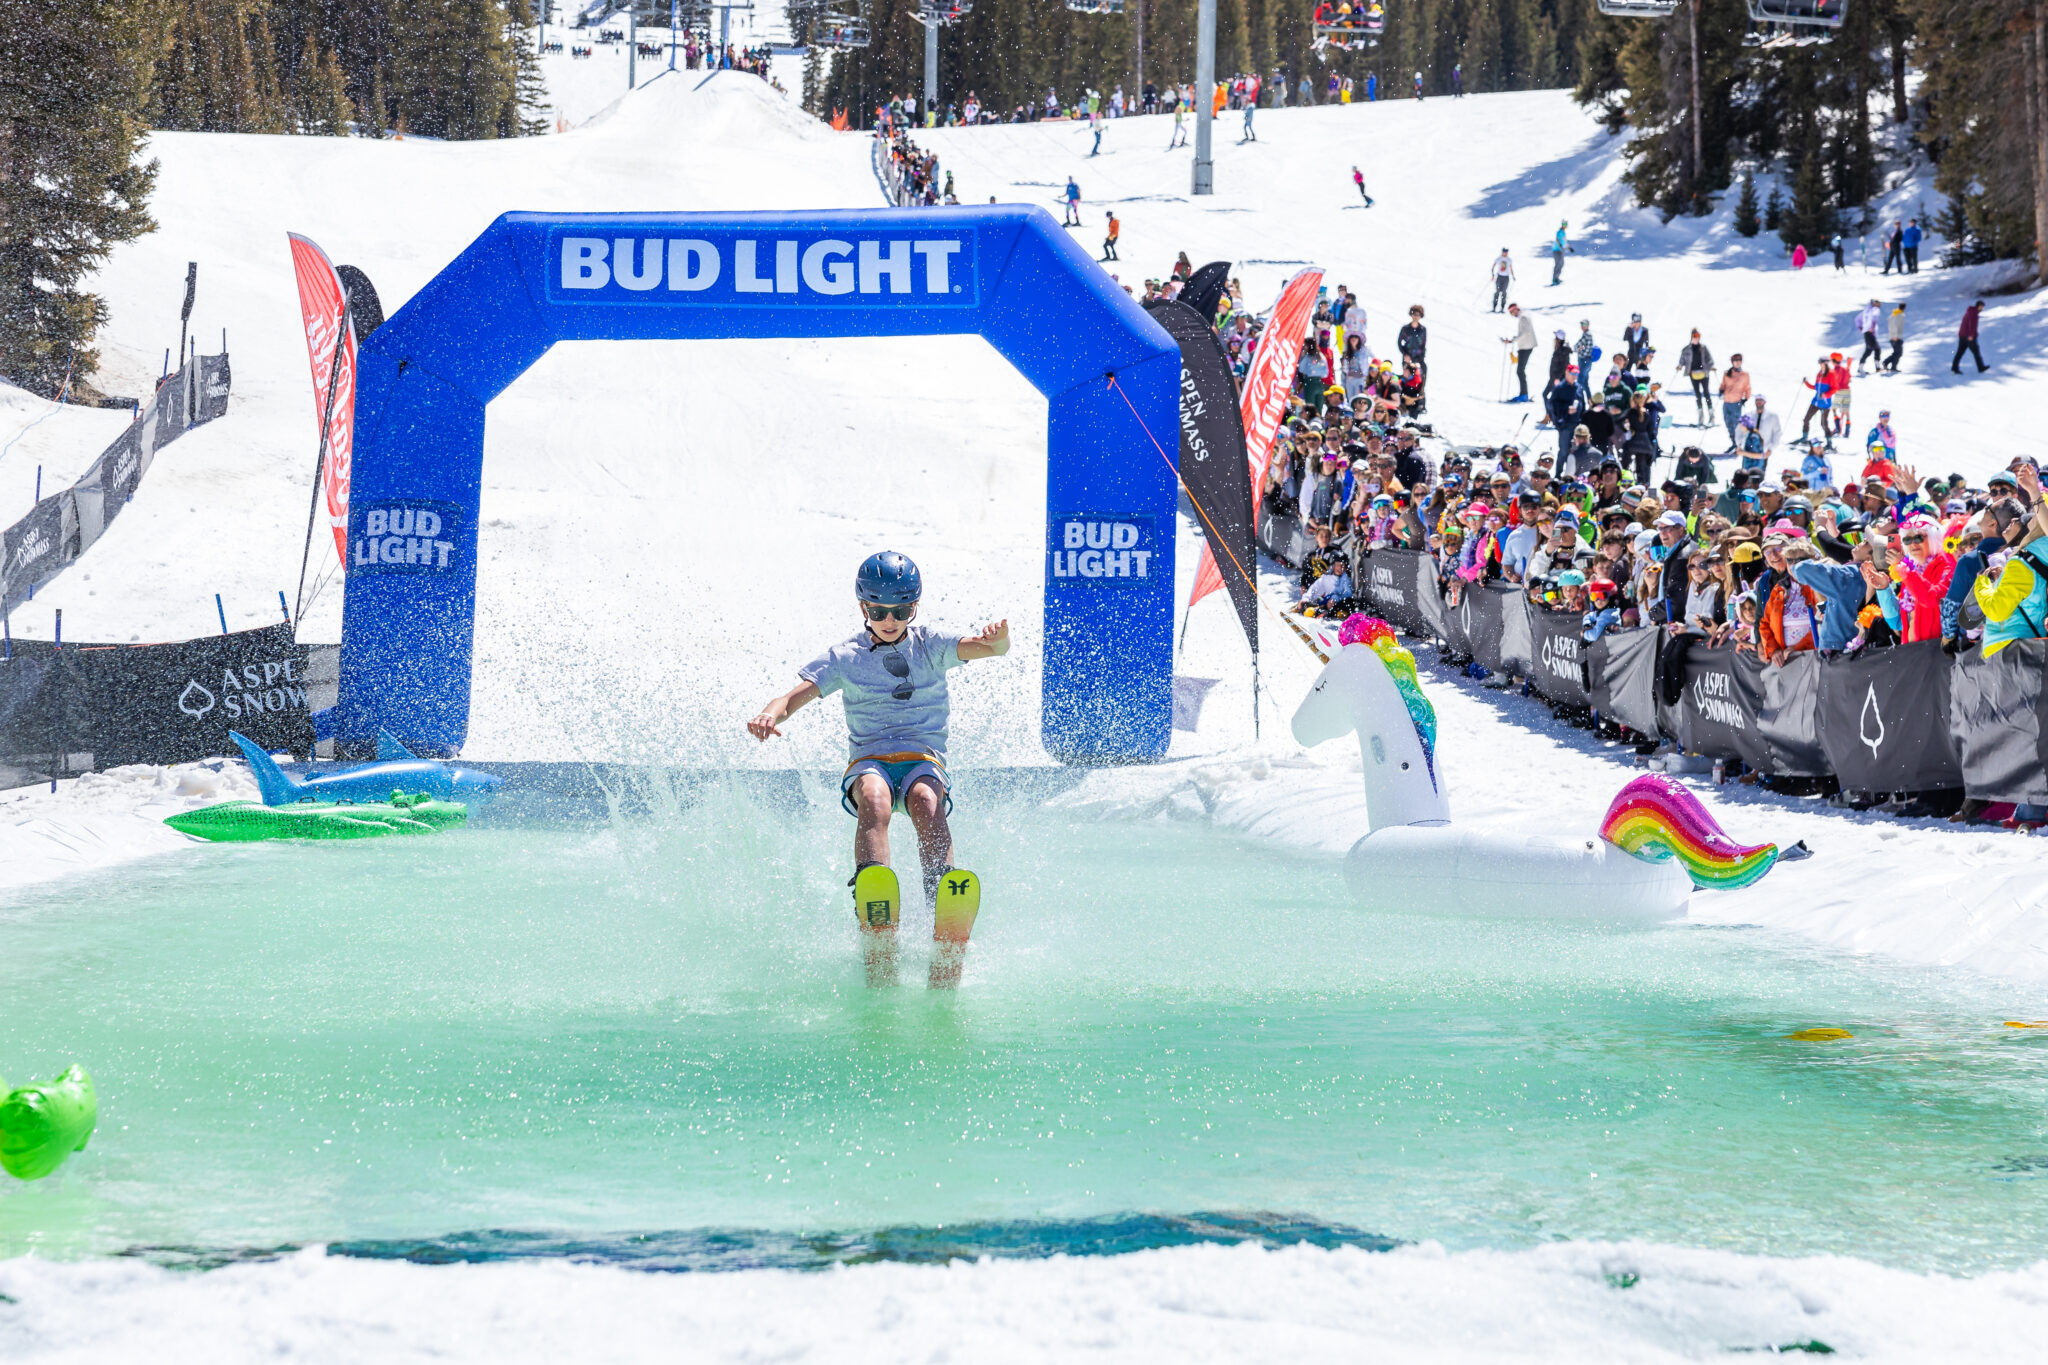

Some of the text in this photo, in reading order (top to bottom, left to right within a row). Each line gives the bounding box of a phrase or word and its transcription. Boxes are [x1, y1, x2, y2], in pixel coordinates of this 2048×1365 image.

[561, 237, 961, 295] BUD LIGHT
[1180, 357, 1207, 417] SPEN
[366, 509, 442, 537] BUD
[1064, 522, 1139, 549] BUD
[355, 536, 454, 567] LIGHT
[1053, 550, 1152, 578] LIGHT
[1552, 634, 1579, 659] ASPEN
[222, 659, 301, 693] ASPE
[1703, 671, 1731, 698] ASPEN
[224, 687, 309, 718] SNOW
